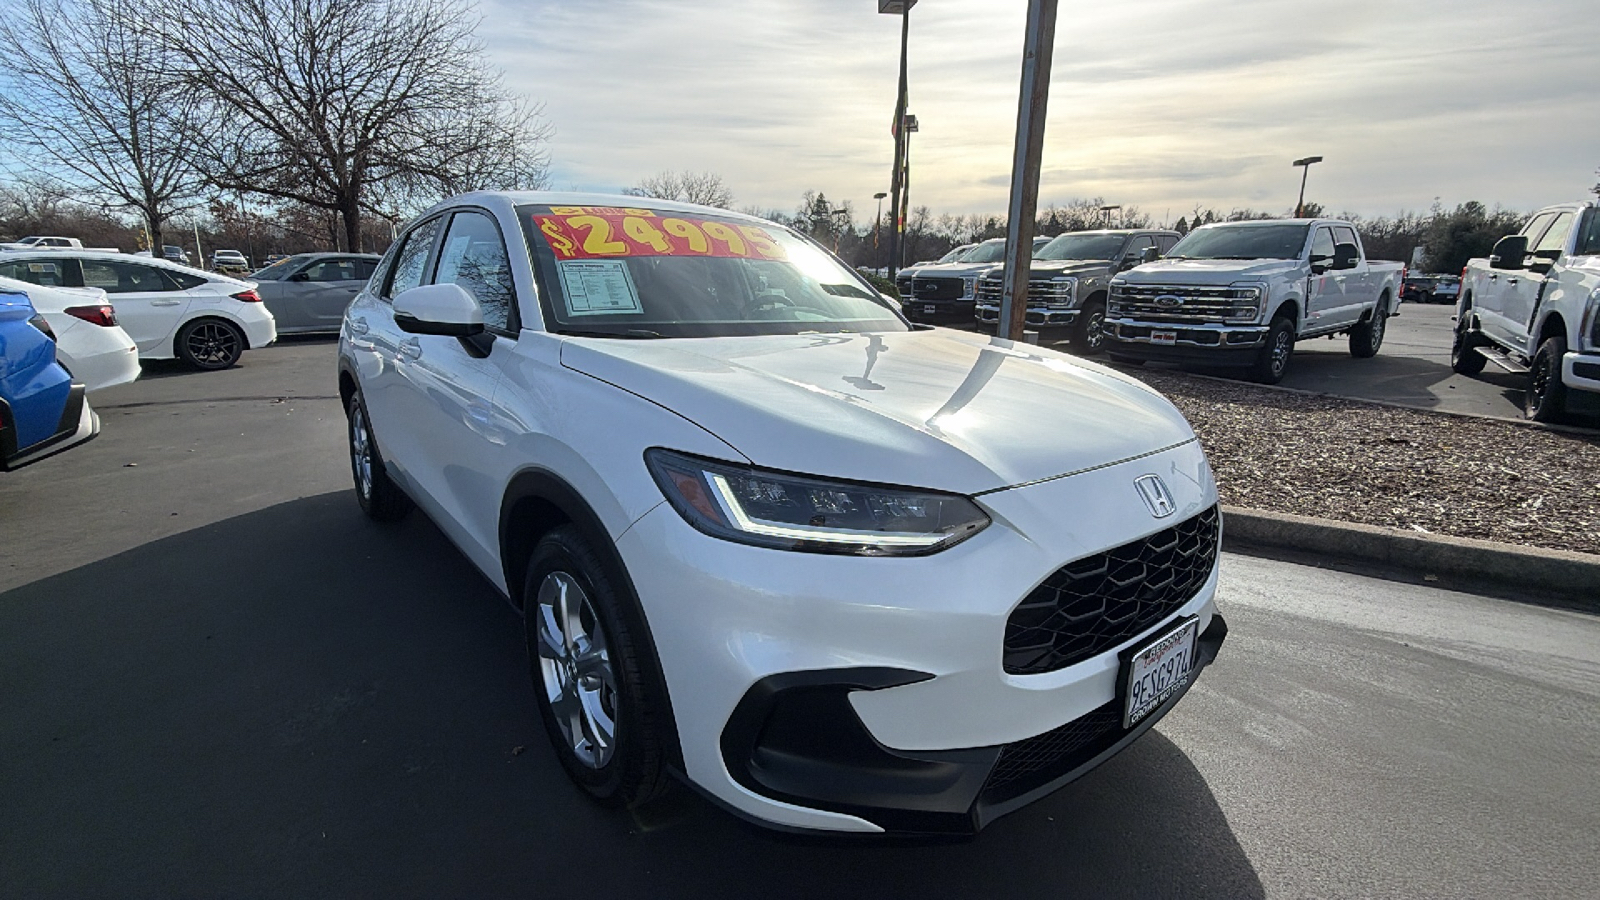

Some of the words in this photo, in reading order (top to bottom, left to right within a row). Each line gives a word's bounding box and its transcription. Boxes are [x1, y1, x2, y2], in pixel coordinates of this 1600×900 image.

[540, 215, 787, 259] $24995
[1131, 697, 1159, 723] CROWN
[1160, 677, 1188, 702] MOTORS
